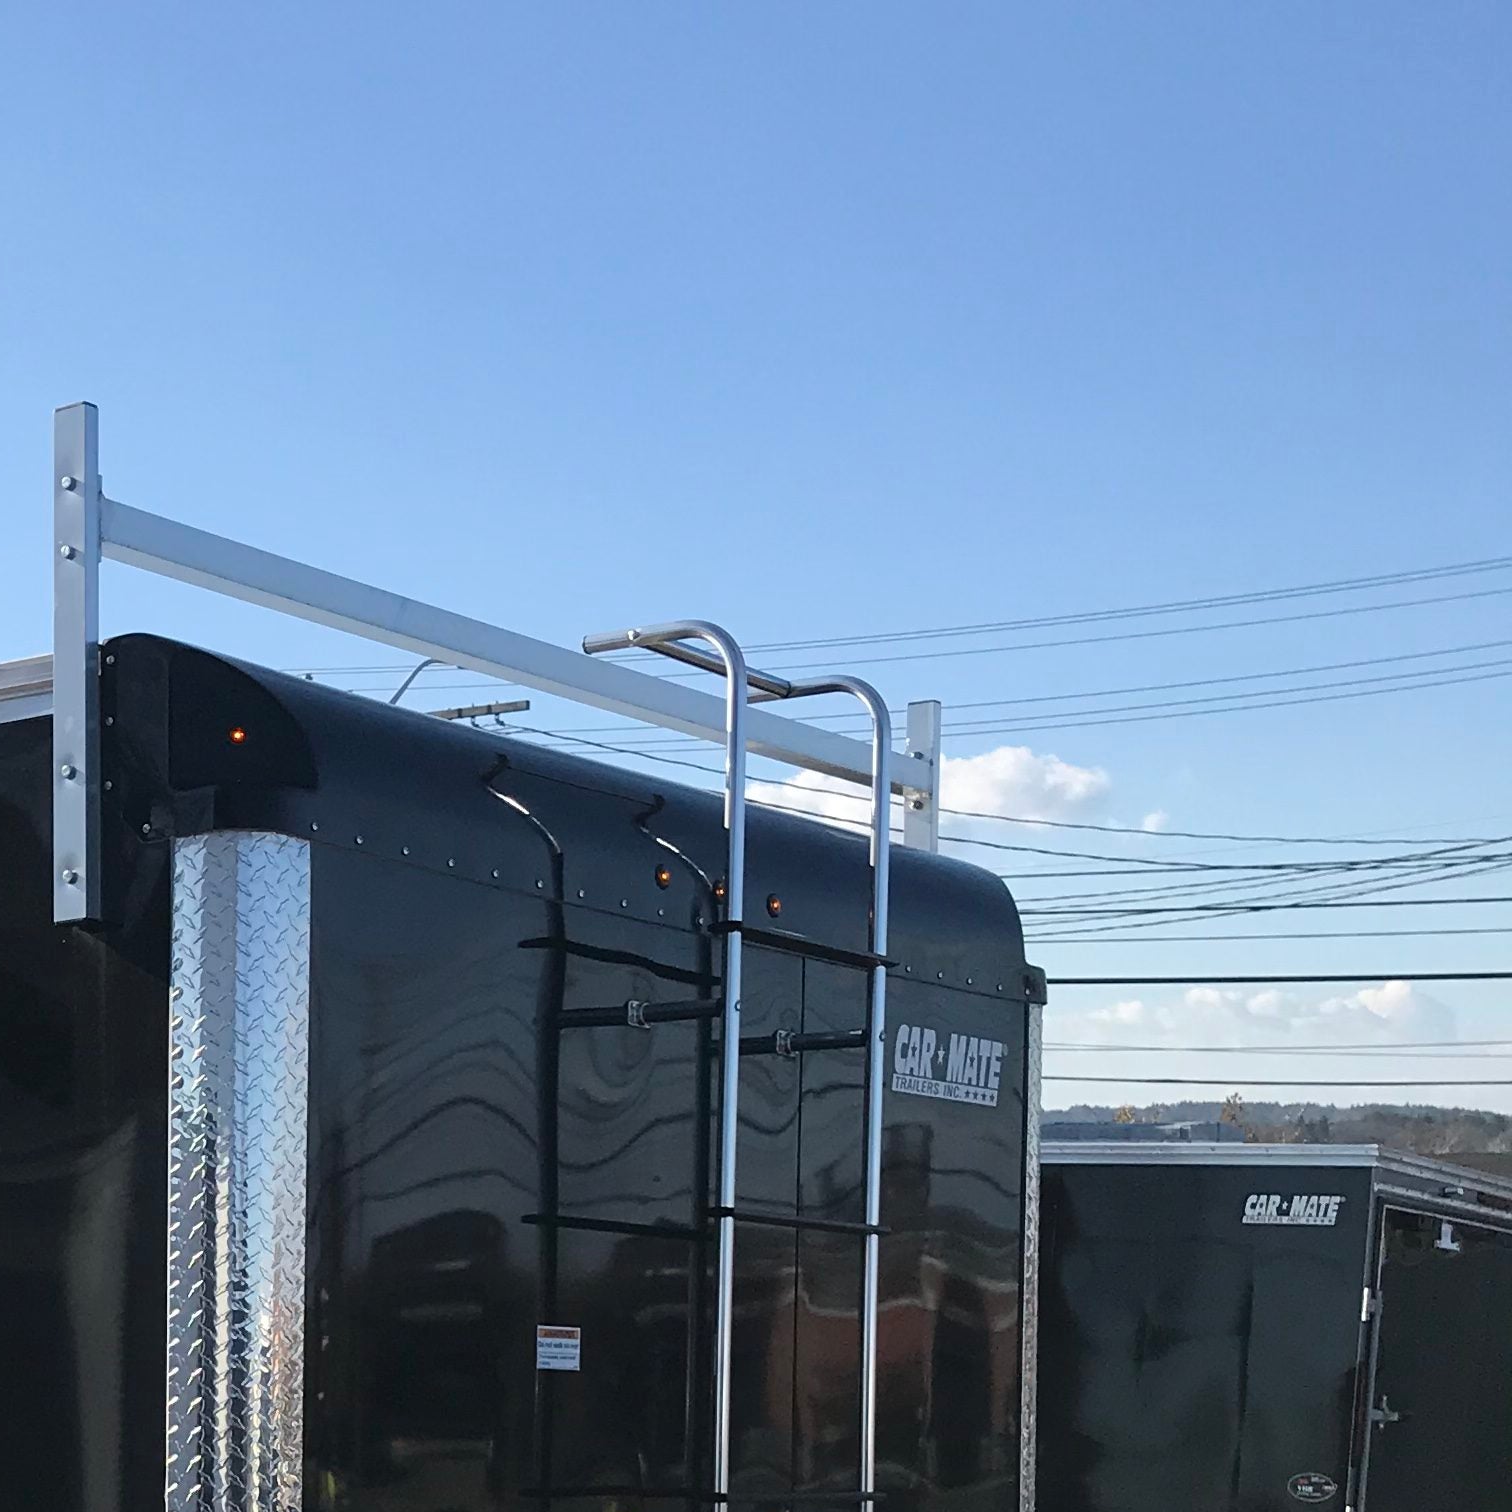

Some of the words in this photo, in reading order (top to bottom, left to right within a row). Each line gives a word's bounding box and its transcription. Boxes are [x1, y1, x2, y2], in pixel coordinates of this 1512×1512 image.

[895, 1024, 937, 1079] CAR
[946, 1033, 1004, 1090] MATE
[895, 1075, 940, 1096] TRAILERS
[943, 1083, 963, 1099] INC.
[1245, 1194, 1281, 1217] CAR
[1289, 1195, 1341, 1218] MATE
